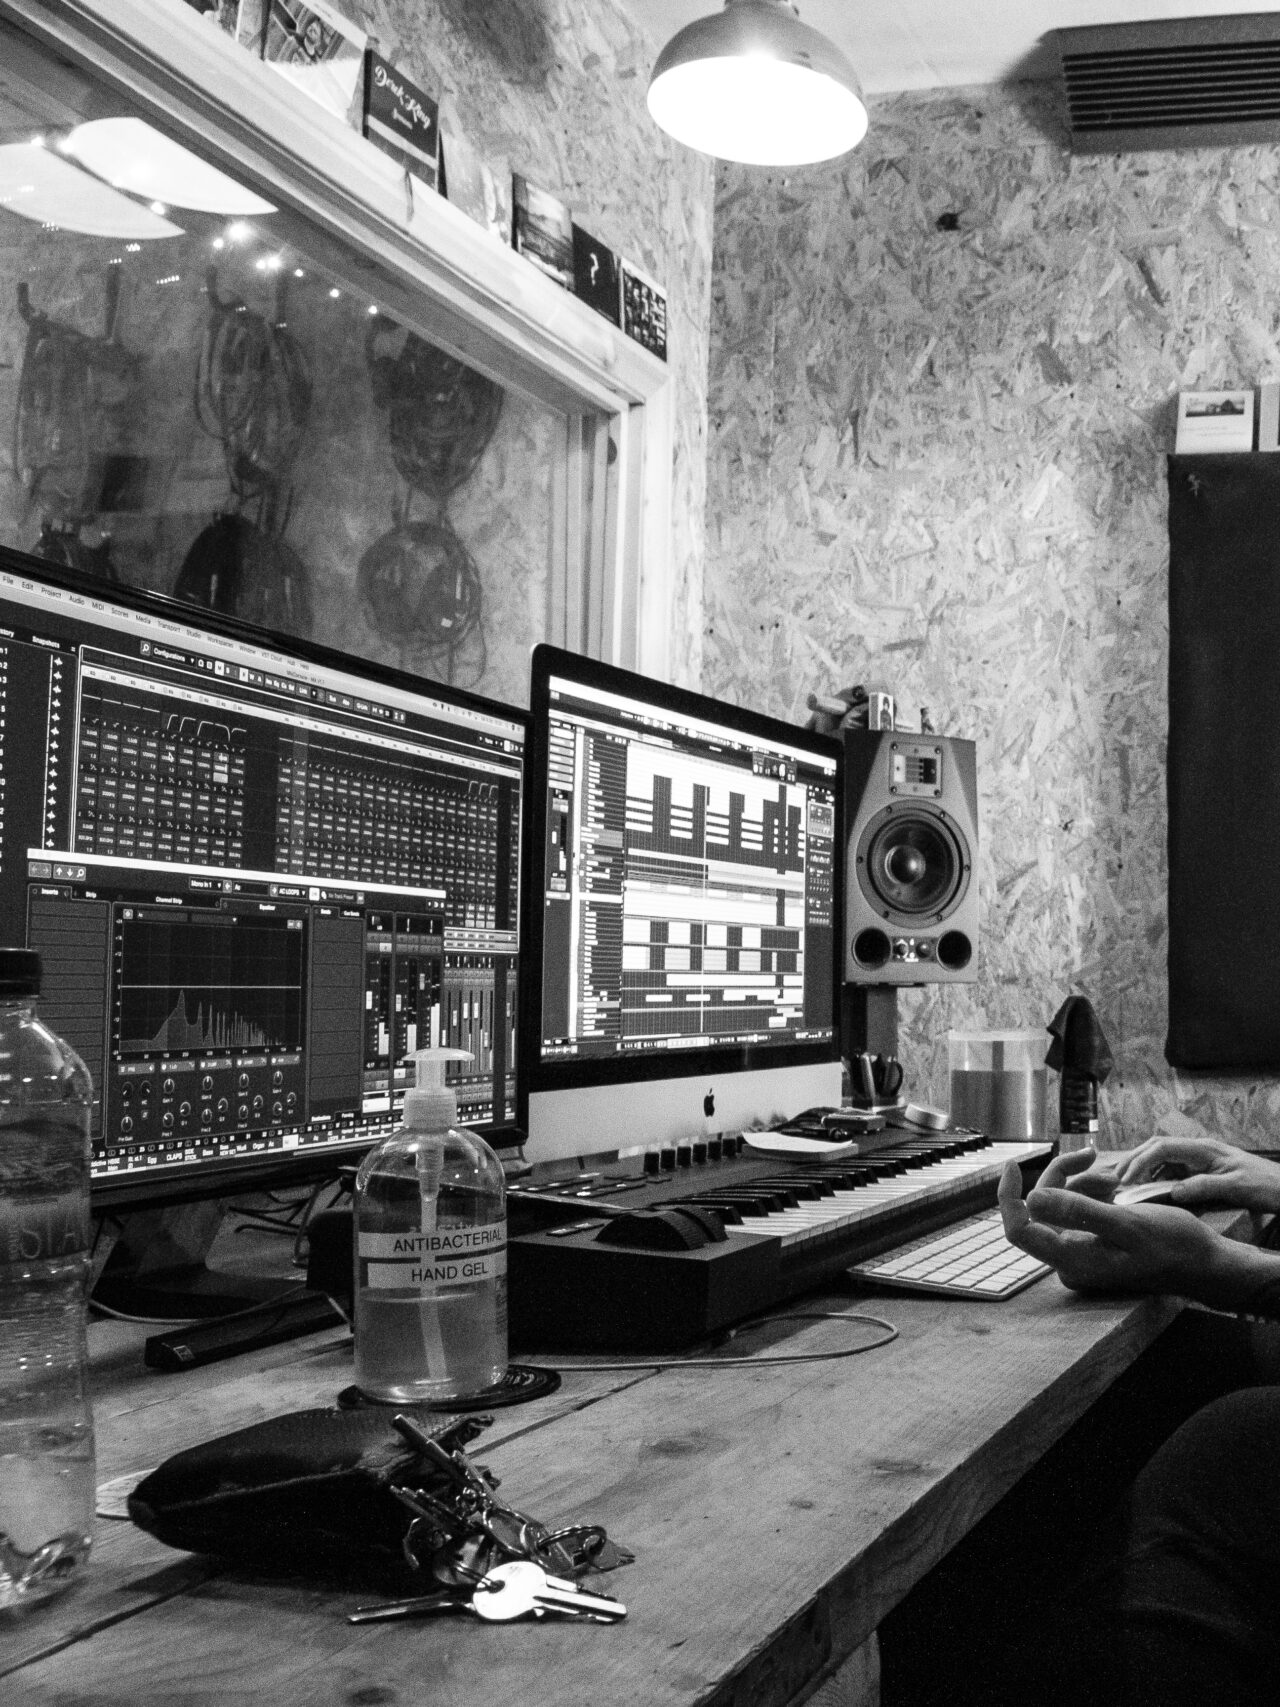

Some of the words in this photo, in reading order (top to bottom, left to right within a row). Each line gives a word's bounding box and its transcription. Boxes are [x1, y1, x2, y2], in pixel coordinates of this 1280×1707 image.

[22, 581, 34, 591] Edit
[41, 586, 62, 598] Project
[69, 595, 85, 606] Audio
[92, 601, 105, 611] MIDI
[111, 607, 129, 618] Scores
[135, 614, 151, 625] Media
[393, 1229, 501, 1251] ANTIBACTERIAL
[411, 1265, 458, 1282] HAND
[462, 1261, 489, 1277] GEL
